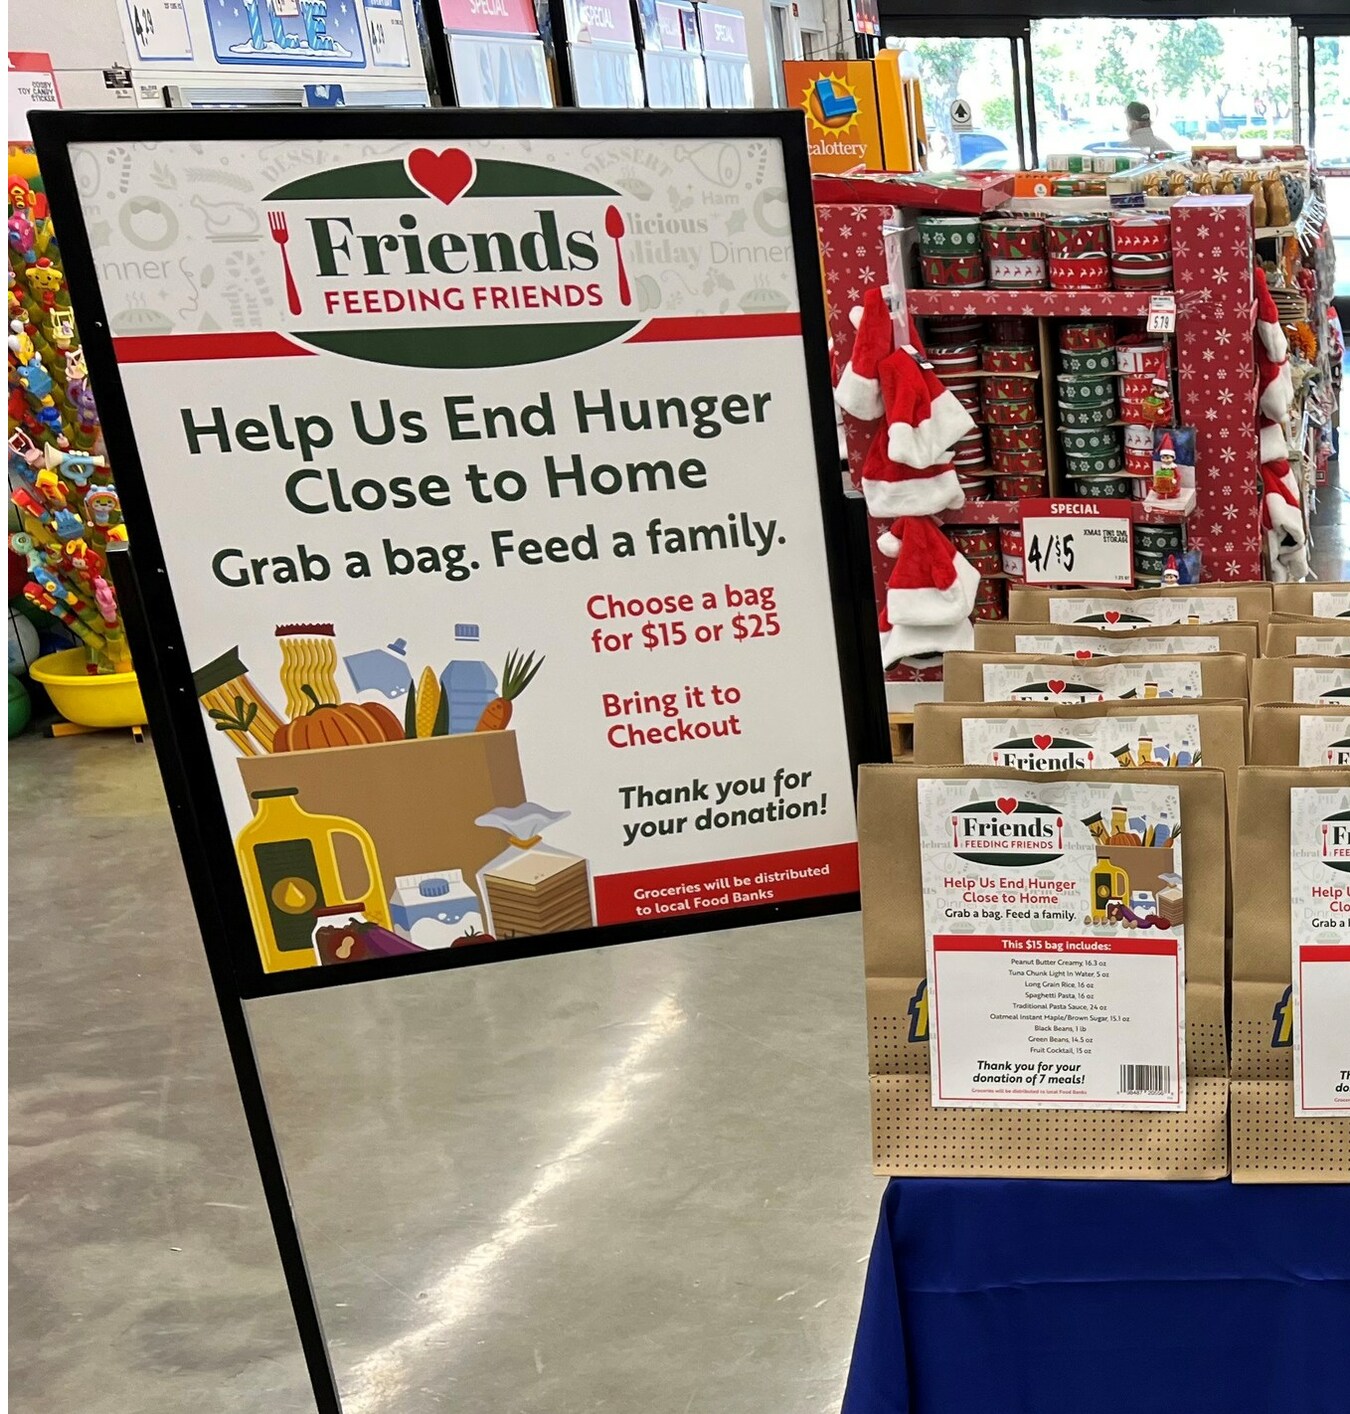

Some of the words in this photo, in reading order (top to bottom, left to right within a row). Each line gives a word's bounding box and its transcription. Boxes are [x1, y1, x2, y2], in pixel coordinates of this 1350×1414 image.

[470, 0, 508, 17] SPECIAL
[808, 141, 868, 159] calottery
[305, 209, 600, 277] Friends
[324, 288, 465, 314] FEEDING
[472, 283, 603, 310] FRIENDS
[1153, 315, 1170, 329] 5.79
[180, 407, 334, 462] Help
[351, 399, 428, 446] Us
[444, 392, 556, 441] End
[574, 388, 772, 438] Hunger
[285, 466, 451, 514] Close
[465, 464, 527, 501] to
[544, 454, 708, 498] Home
[1050, 503, 1100, 514] SPECIAL
[212, 545, 331, 587] Grab
[346, 547, 371, 580] a
[382, 540, 480, 582] bag.
[491, 525, 600, 568] Feed
[612, 531, 635, 558] a
[645, 513, 787, 556] family.
[1027, 533, 1075, 573] 4/$5
[587, 593, 694, 620] Choose
[702, 591, 717, 610] a
[725, 584, 776, 610] bag
[591, 629, 633, 653] for
[641, 620, 687, 652] $15
[694, 622, 724, 643] or
[731, 612, 781, 643] $25
[602, 690, 679, 717] Bring
[684, 685, 706, 709] it
[711, 685, 741, 705] to
[607, 714, 742, 749] Checkout
[619, 779, 709, 809] Thank
[716, 774, 766, 804] you
[774, 768, 812, 798] for
[623, 812, 688, 847] your
[695, 793, 828, 831] donation!
[963, 817, 1054, 837] Friends
[965, 840, 1008, 849] FEEDING
[1011, 840, 1053, 849] FRIENDS
[633, 882, 701, 900] Groceries
[704, 877, 731, 891] will
[733, 875, 751, 887] be
[754, 864, 830, 884] distributed
[944, 877, 975, 890] Help
[980, 877, 995, 889] Us
[999, 878, 1025, 890] End
[1028, 878, 1076, 892] Hunger
[636, 904, 652, 916] to
[655, 898, 691, 912] local
[694, 894, 730, 909] Food
[733, 888, 774, 903] Banks
[963, 892, 999, 903] Close
[1002, 893, 1015, 904] to
[1019, 893, 1058, 904] Home
[1002, 939, 1023, 949] This
[1026, 939, 1042, 950] $15
[1044, 940, 1063, 952] bag
[1066, 940, 1111, 951] includes:
[1057, 959, 1083, 968] Creamy,
